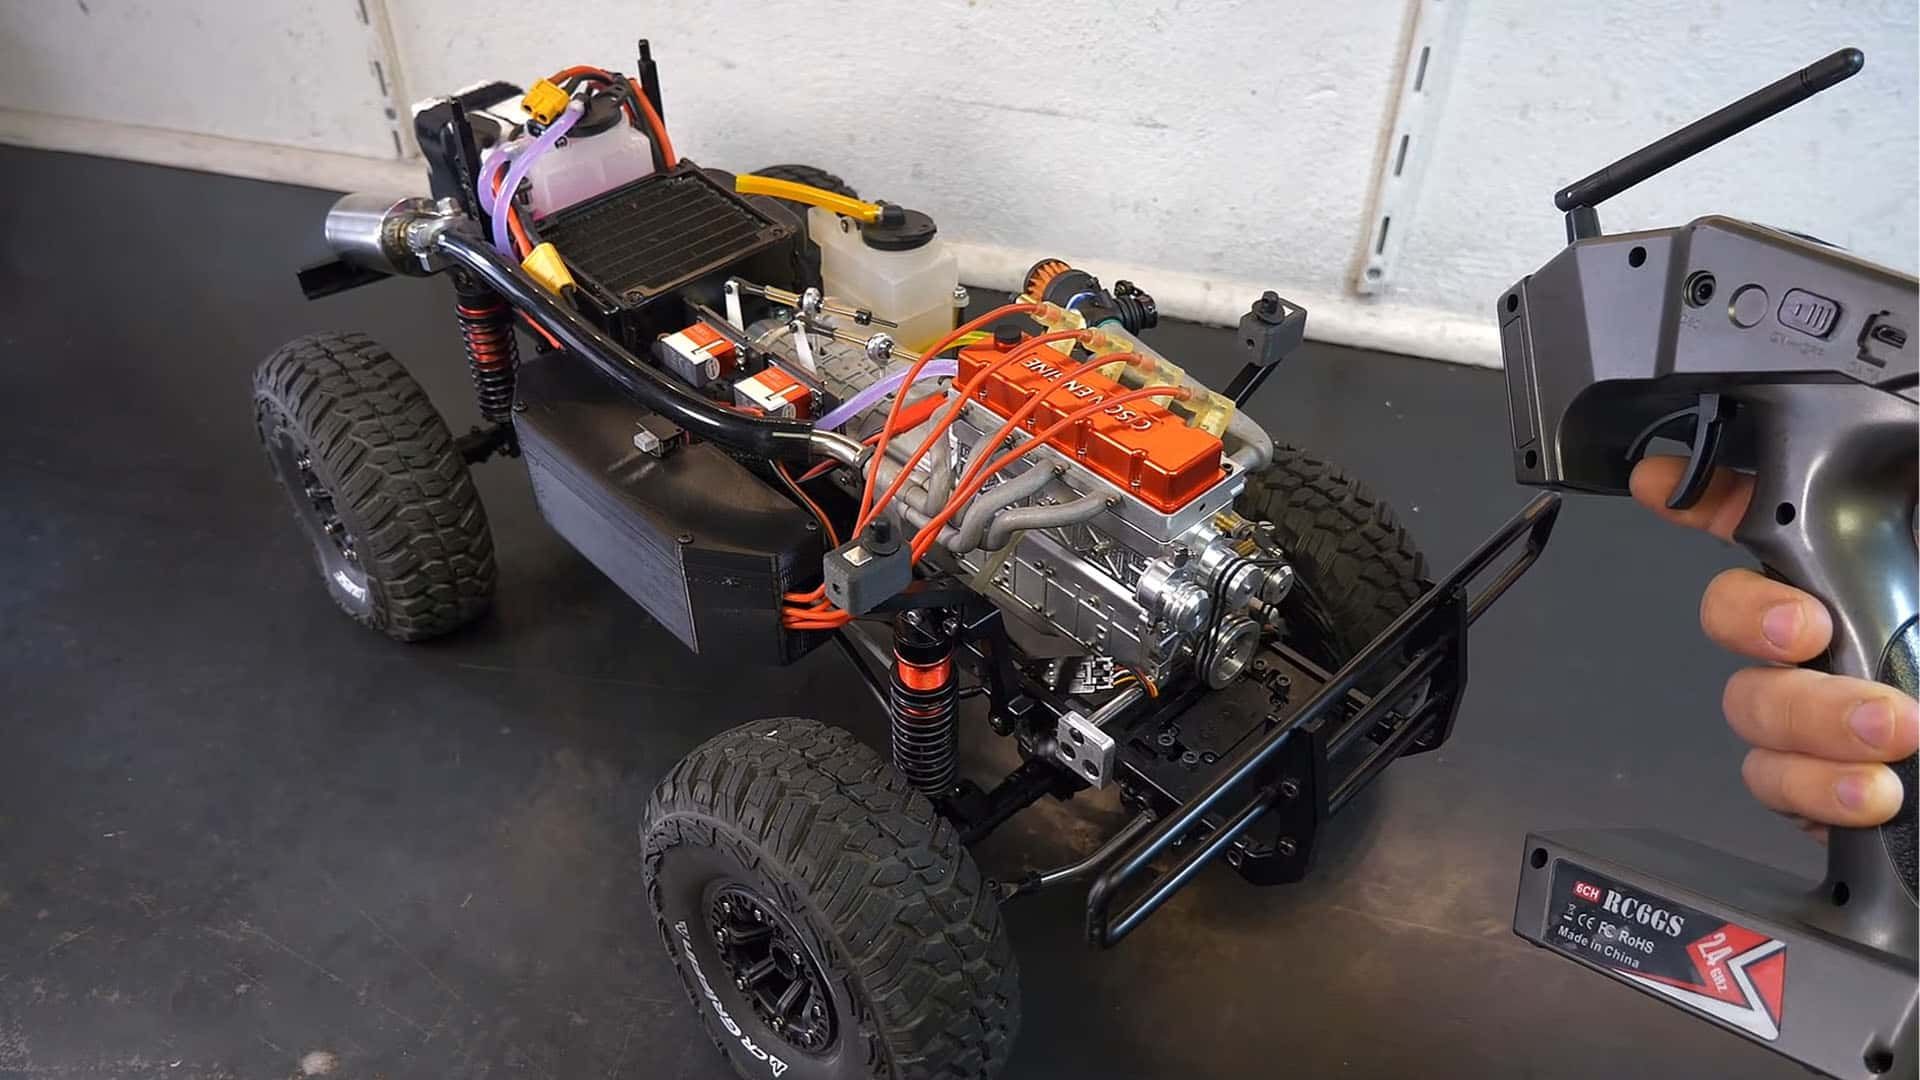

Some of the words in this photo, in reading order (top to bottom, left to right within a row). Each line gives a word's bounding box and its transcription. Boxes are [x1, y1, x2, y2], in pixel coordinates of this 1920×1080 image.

[1576, 883, 1599, 900] 6CH
[1602, 889, 1685, 937] RC6GS
[1558, 925, 1589, 947] Made
[1590, 938, 1602, 952] in
[1604, 945, 1640, 969] China
[1618, 930, 1655, 954] RoHS
